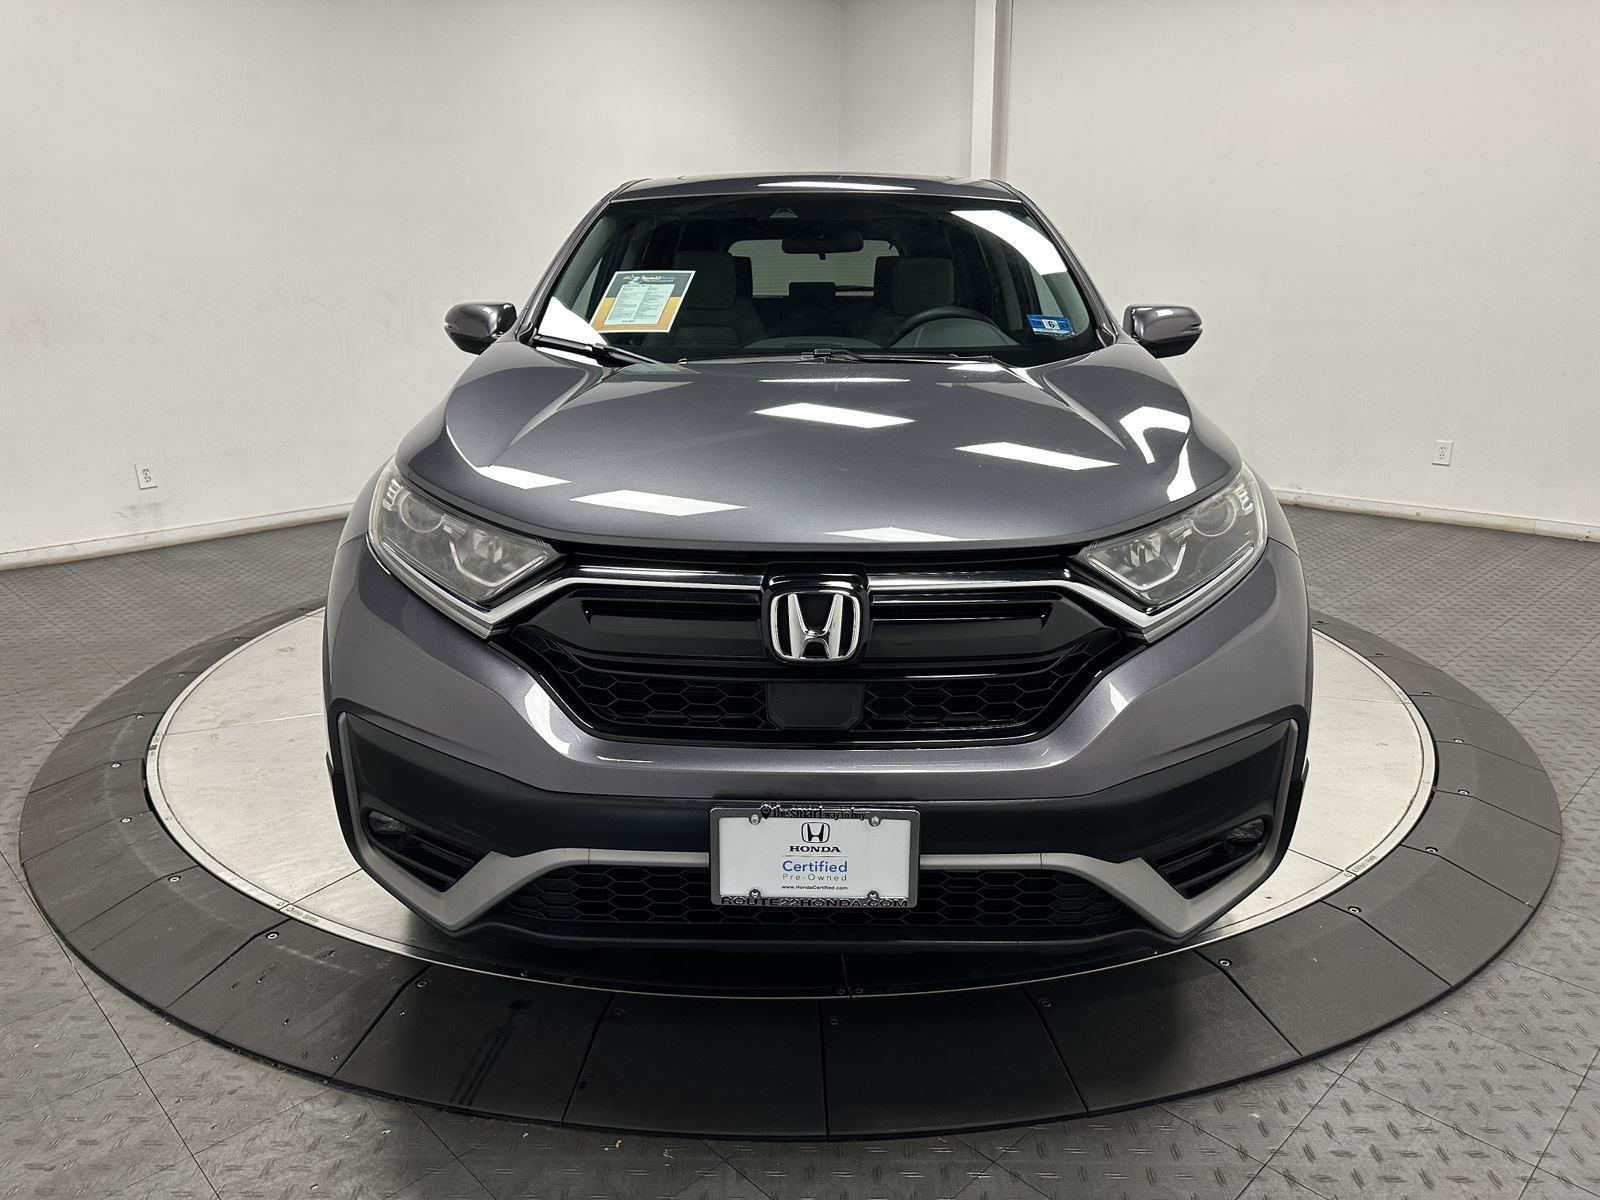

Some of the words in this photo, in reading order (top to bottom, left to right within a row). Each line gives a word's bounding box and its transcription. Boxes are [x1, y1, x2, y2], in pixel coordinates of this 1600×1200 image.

[1048, 320, 1055, 328] 6
[773, 805, 790, 818] the
[790, 806, 823, 819] smart
[825, 811, 839, 820] way
[789, 845, 841, 853] HONDA
[782, 860, 848, 873] Certified
[782, 873, 848, 882] Pre-Owned
[720, 897, 908, 907] ROUTE22HONDA.COM
